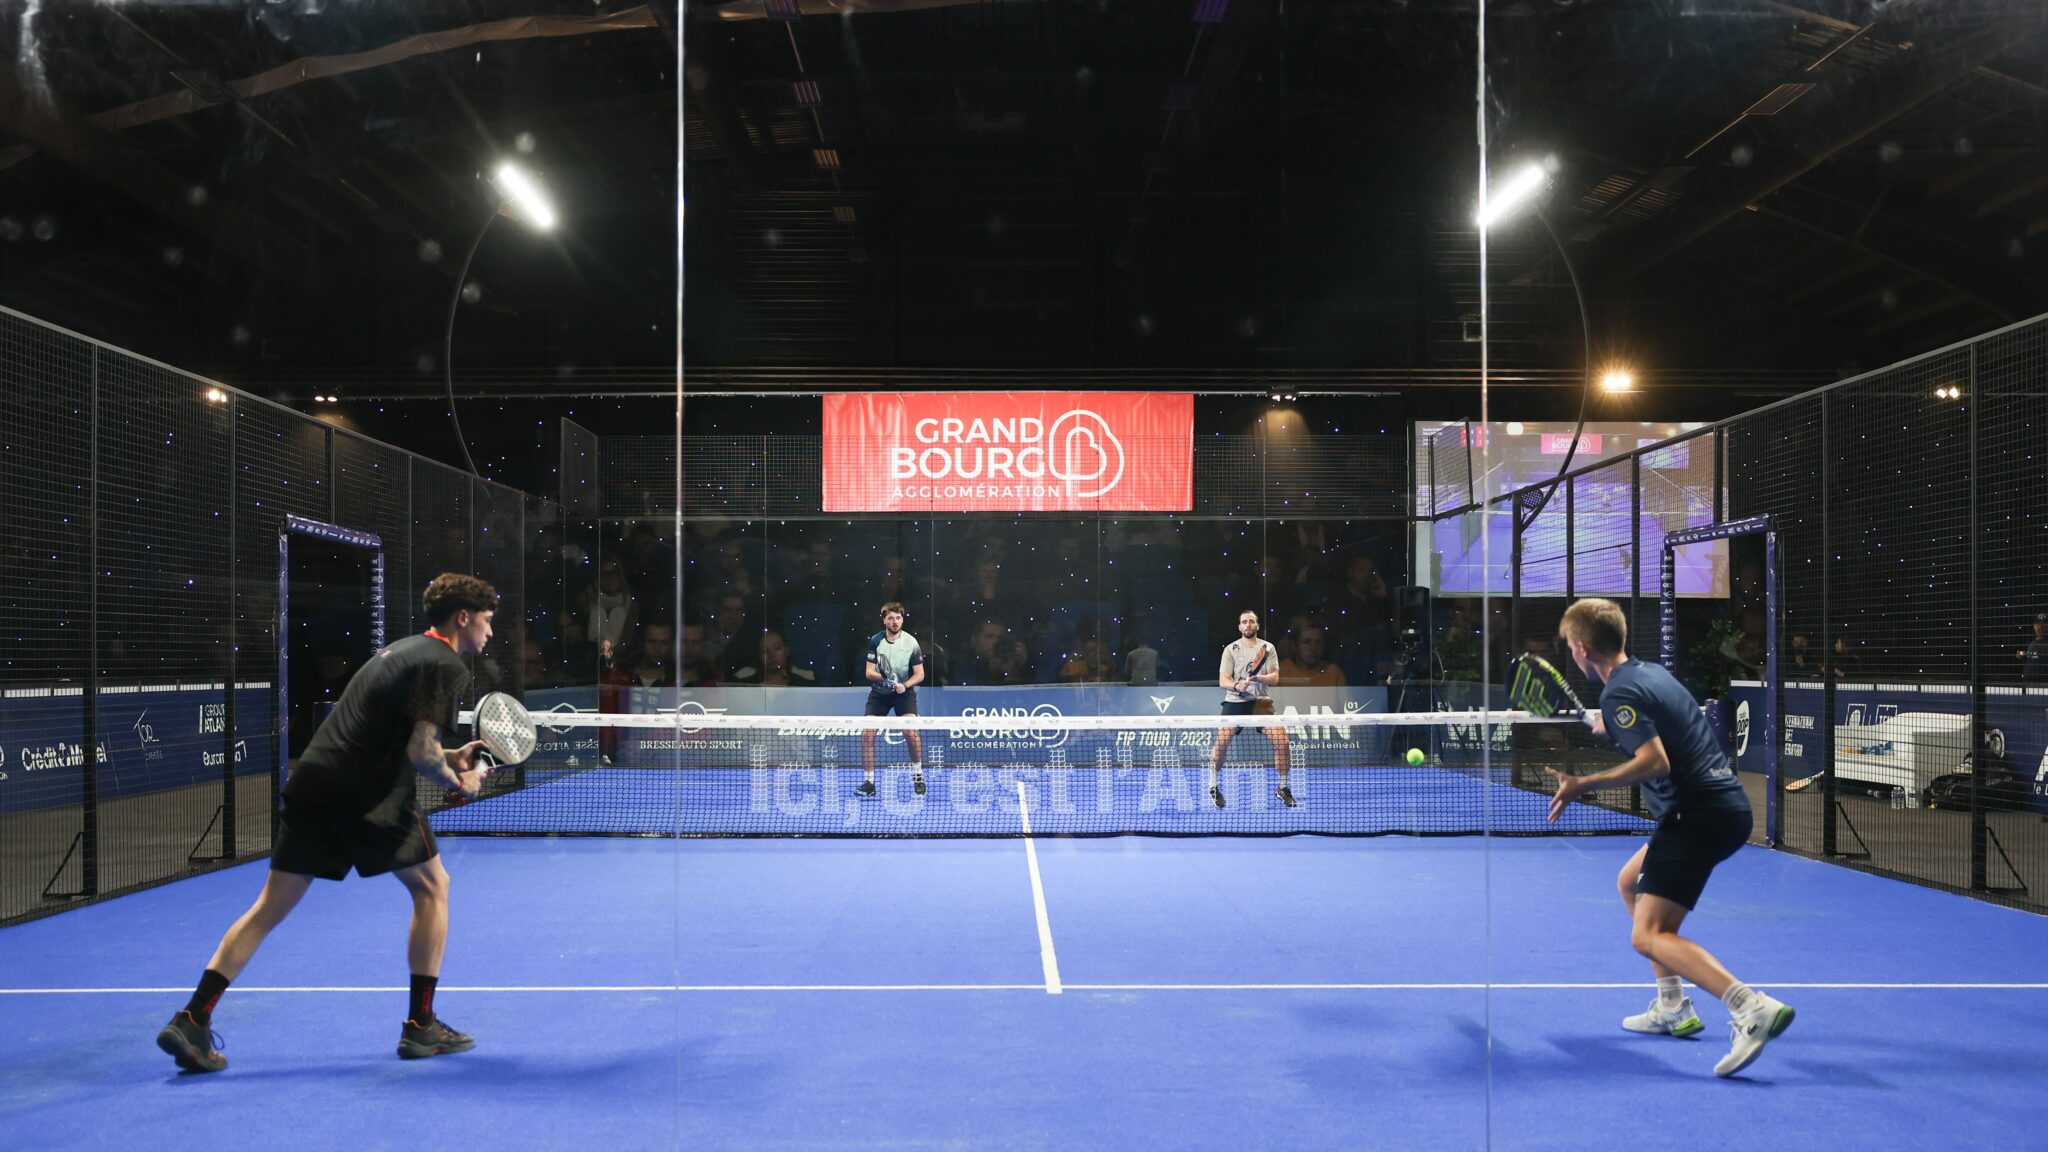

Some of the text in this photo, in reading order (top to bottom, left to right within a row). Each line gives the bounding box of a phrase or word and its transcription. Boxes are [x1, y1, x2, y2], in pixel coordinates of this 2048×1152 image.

[915, 417, 1044, 444] GRAND
[891, 447, 1046, 480] BOURG
[892, 483, 1060, 498] AGGLOMÉRATION
[205, 703, 225, 717] GROU
[962, 707, 1028, 718] GRAND
[1347, 701, 1358, 710] 01
[1282, 705, 1352, 741] AIN
[640, 740, 743, 750] BRESSE AUTO SPORT
[950, 740, 1037, 749] AGGLOMÉRATION
[1115, 731, 1212, 746] FIP TOUR 2023
[1289, 740, 1361, 751] Département
[21, 746, 57, 772] Crédit
